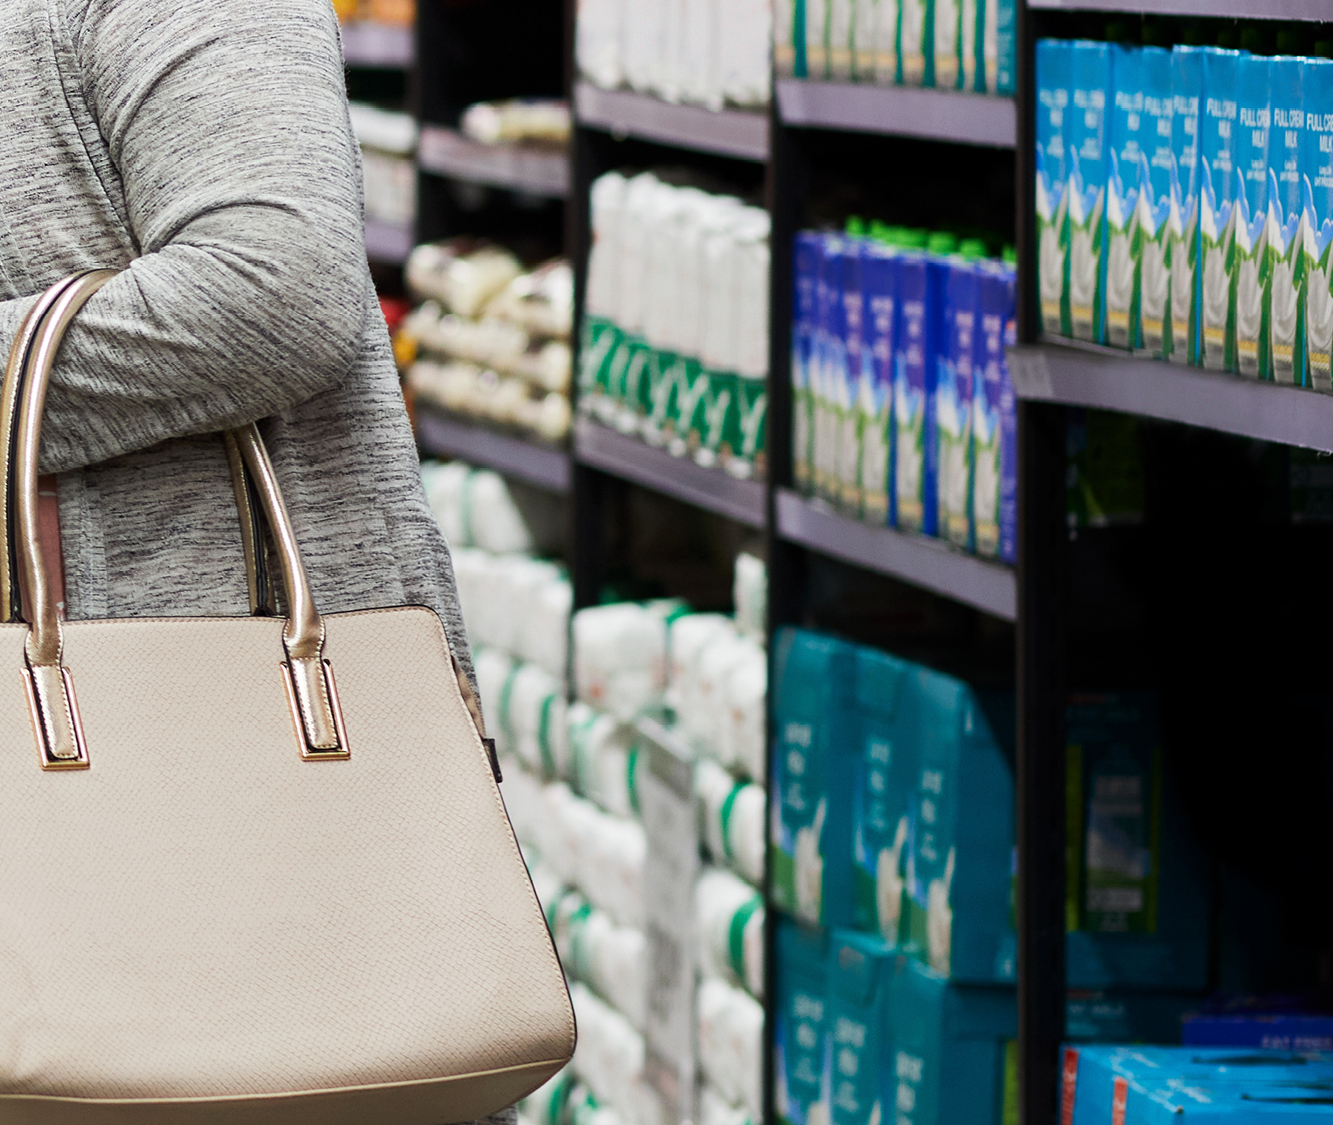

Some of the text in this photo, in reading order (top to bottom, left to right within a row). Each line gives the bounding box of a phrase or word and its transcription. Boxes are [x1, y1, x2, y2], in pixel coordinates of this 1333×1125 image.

[1240, 107, 1256, 127] FULL
[1274, 107, 1289, 127] FULL
[1306, 113, 1323, 132] FULL
[1285, 130, 1298, 148] MILK
[1319, 134, 1333, 153] MILK
